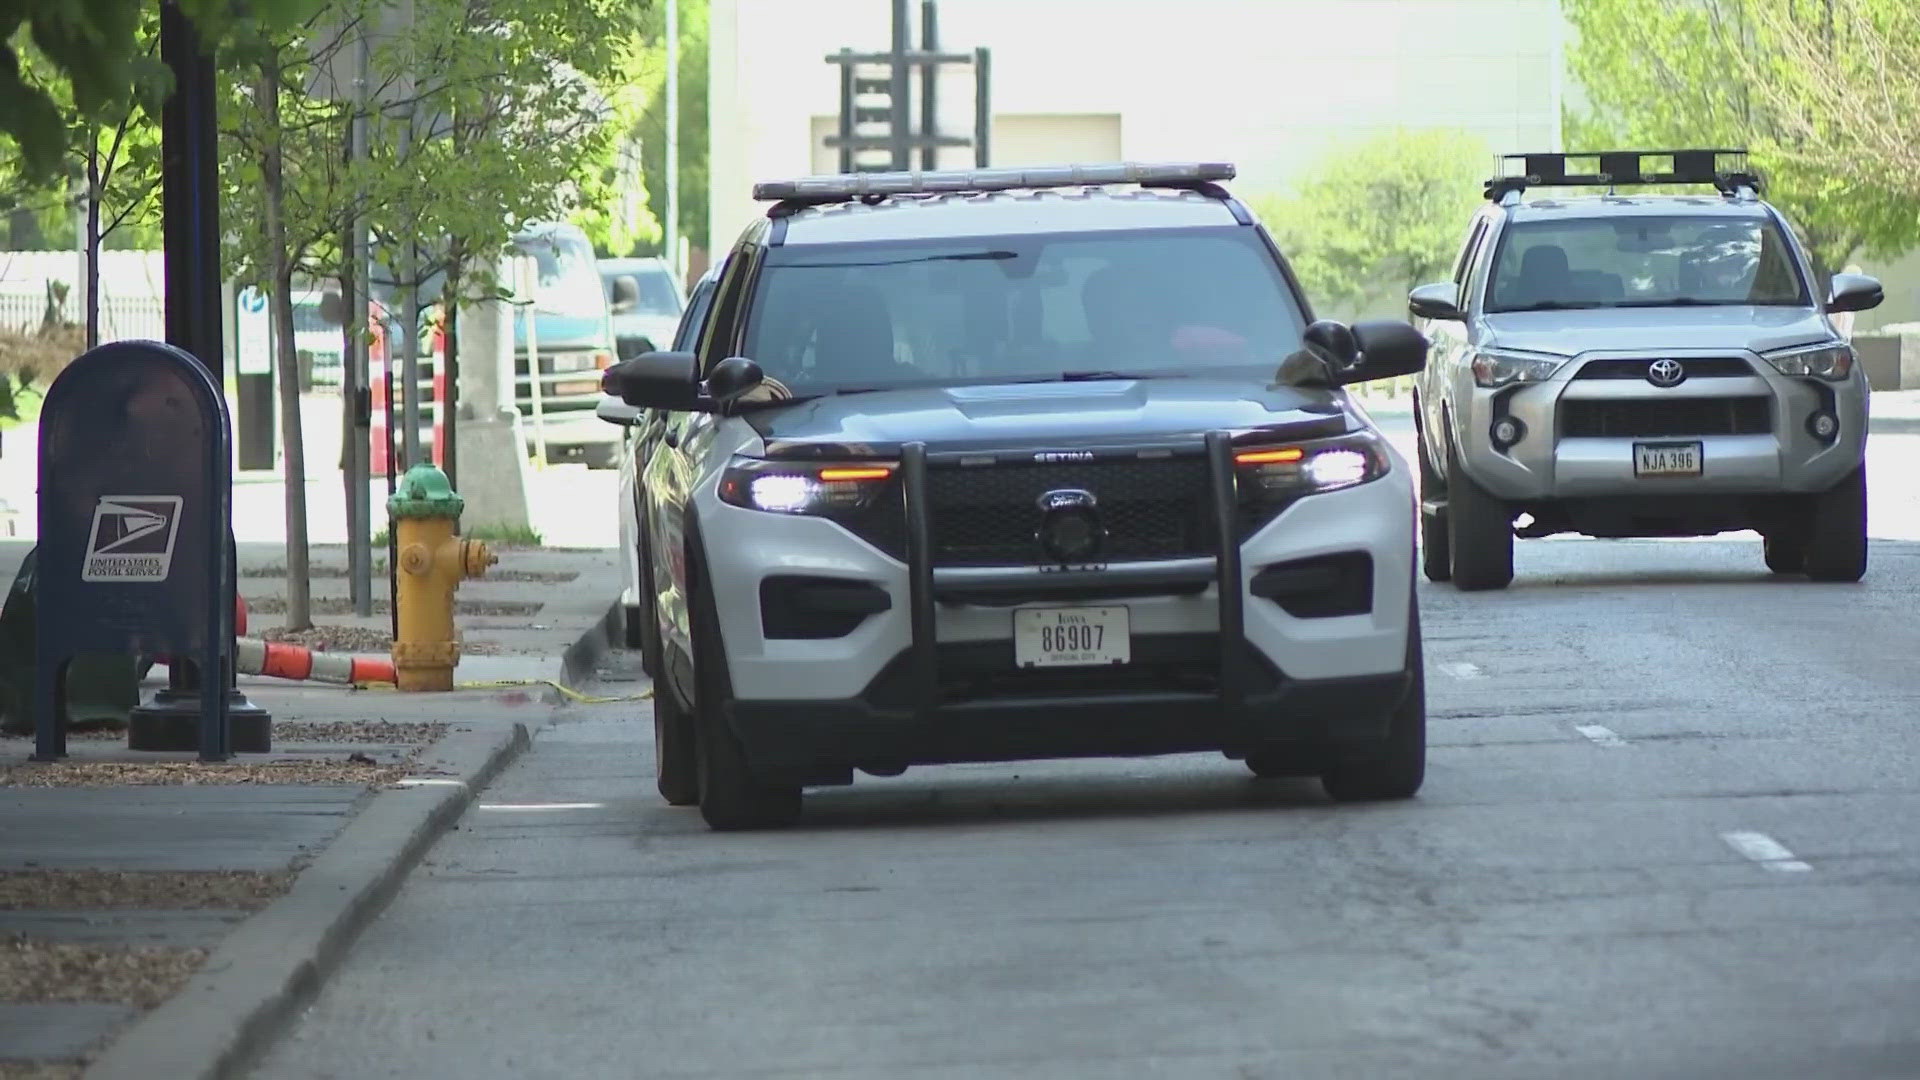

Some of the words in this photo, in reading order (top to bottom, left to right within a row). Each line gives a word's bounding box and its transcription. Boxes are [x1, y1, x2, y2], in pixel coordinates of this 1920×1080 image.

[1642, 453, 1666, 471] NJA
[1670, 452, 1693, 469] 396
[90, 558, 126, 567] UNITED
[127, 558, 161, 567] STATES
[88, 567, 122, 576] POSTAL
[124, 567, 162, 576] SERVICE
[1042, 625, 1104, 652] 86907
